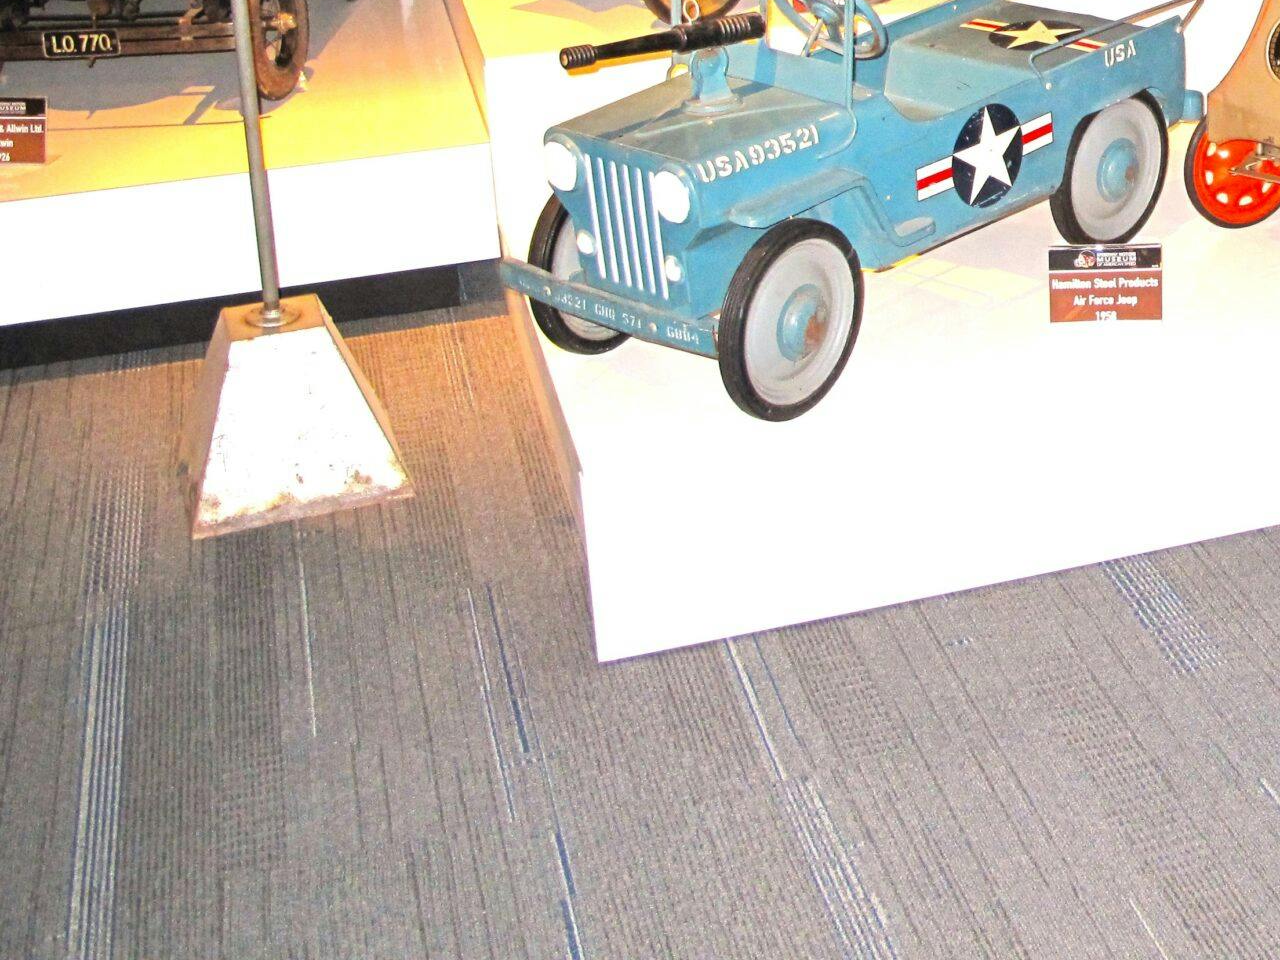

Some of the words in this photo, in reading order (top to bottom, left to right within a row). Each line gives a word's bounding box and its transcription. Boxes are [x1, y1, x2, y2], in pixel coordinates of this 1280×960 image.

[1105, 40, 1136, 67] USA
[6, 124, 28, 133] Allwin
[697, 125, 819, 182] USA93521
[1052, 279, 1091, 289] Hamilton
[1094, 278, 1116, 288] Steel
[1119, 277, 1158, 288] Products
[1073, 295, 1086, 305] Air
[1089, 295, 1114, 305] Force
[1117, 294, 1138, 306] Jeep
